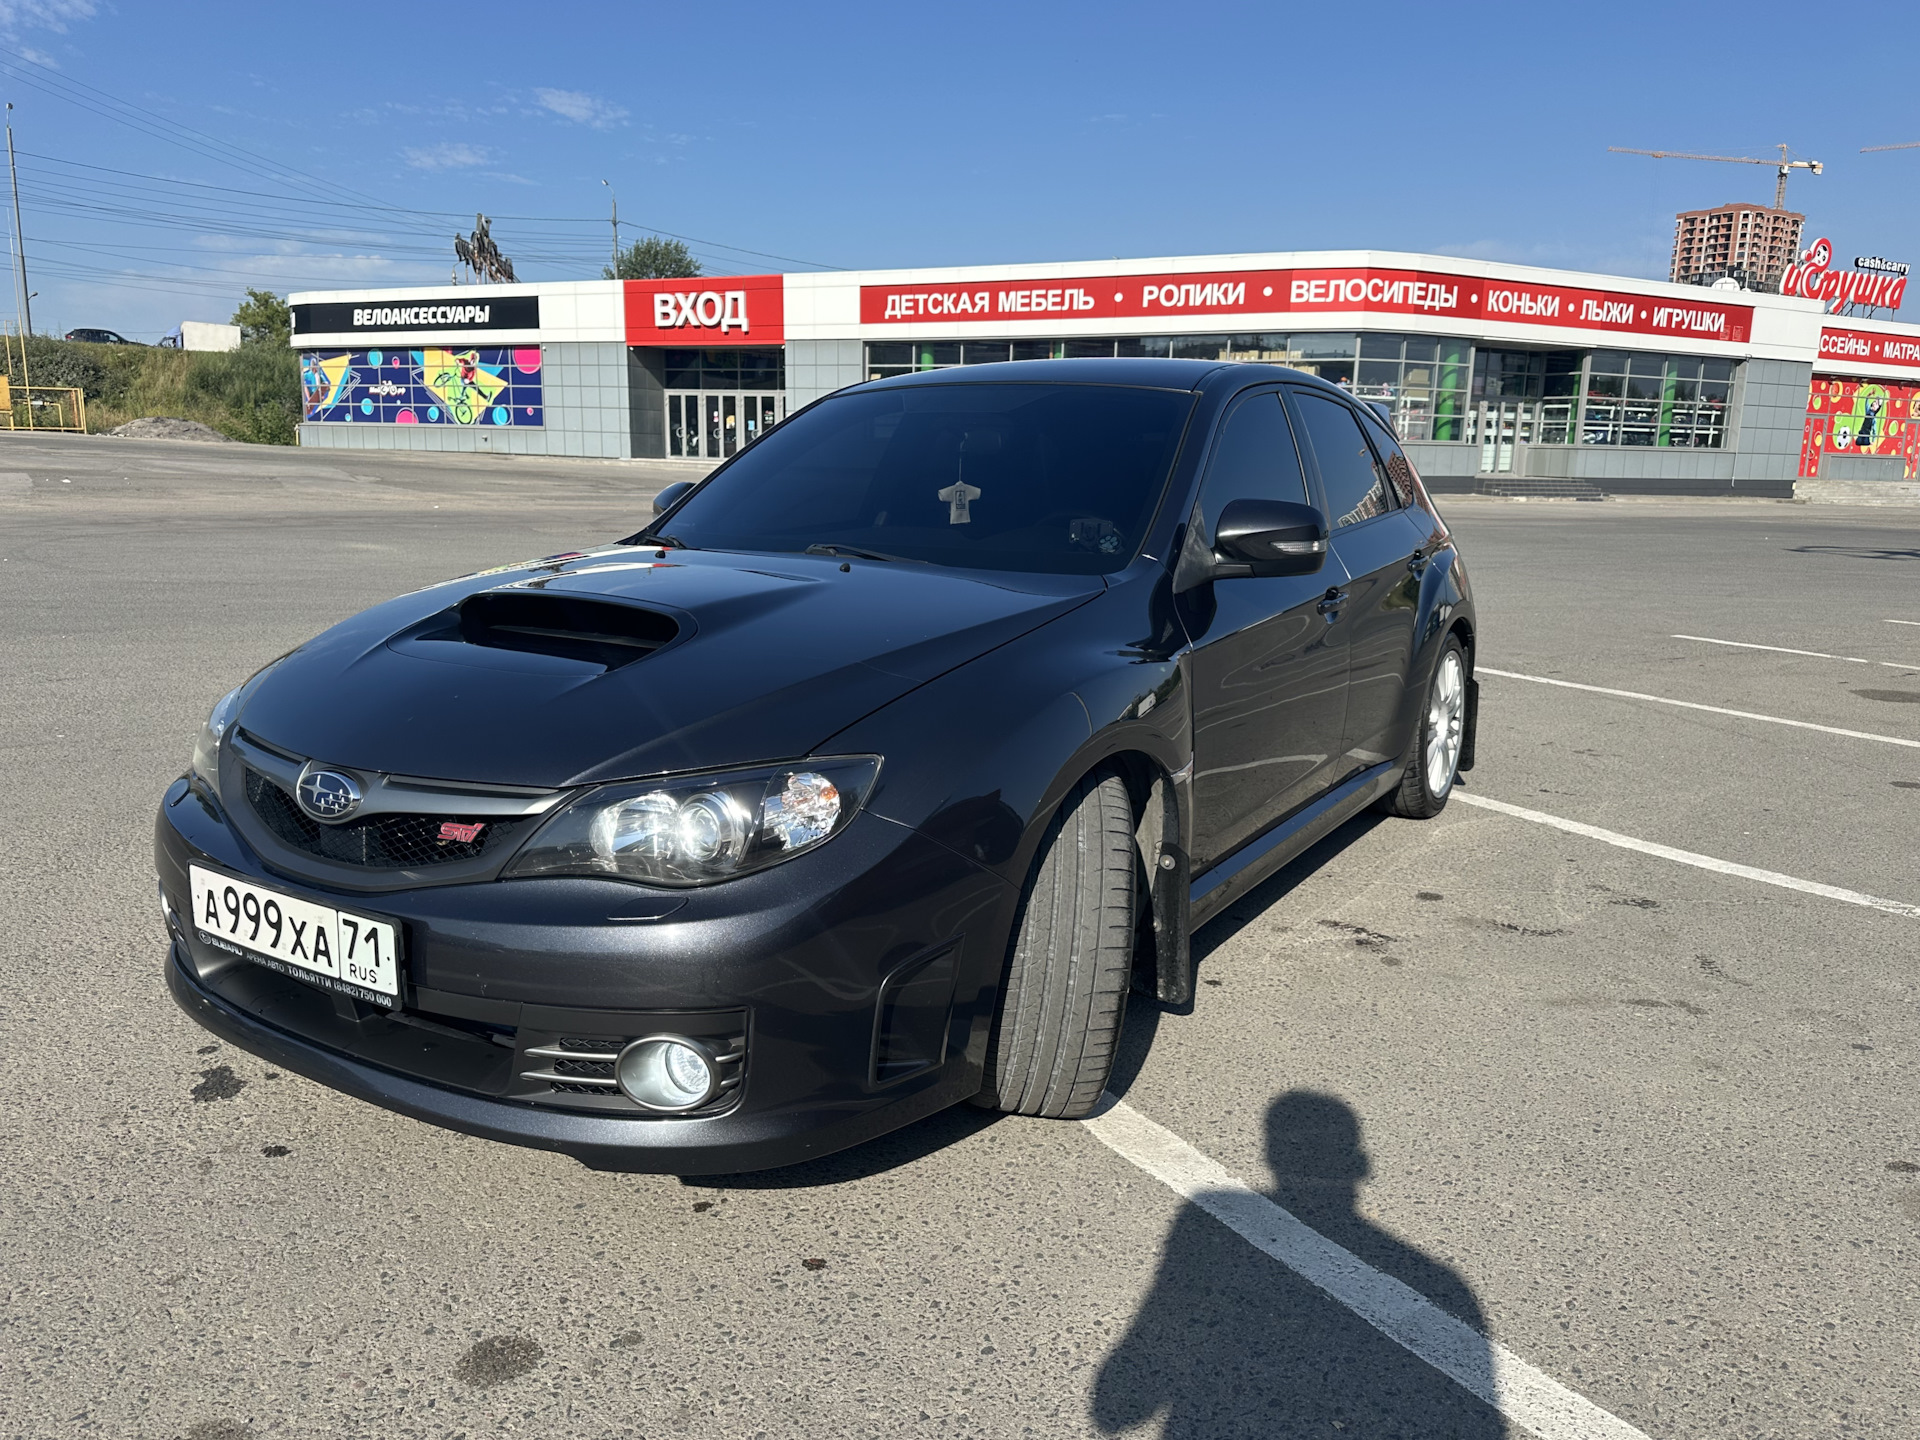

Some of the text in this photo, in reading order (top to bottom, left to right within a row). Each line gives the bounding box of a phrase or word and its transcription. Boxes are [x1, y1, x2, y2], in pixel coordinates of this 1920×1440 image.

[1858, 257, 1911, 275] cash&carry
[353, 305, 490, 326] ВЕЛОАКСЕССУАРЫ
[653, 290, 749, 332] ВХОД
[885, 278, 1726, 333] ДЕТСКАЯ МЕБЕЛЬ РОЛИКИ ВЕЛОСИПЕДЫ КОНЬКИ ЛЫЖИ ИГРУШКИ
[342, 918, 381, 968] 71
[211, 937, 243, 956] SUBARU
[287, 965, 332, 988] ТОЛЬЯТТИ
[359, 988, 375, 1001] 750
[376, 994, 392, 1007] 000
[349, 963, 377, 984] RUS
